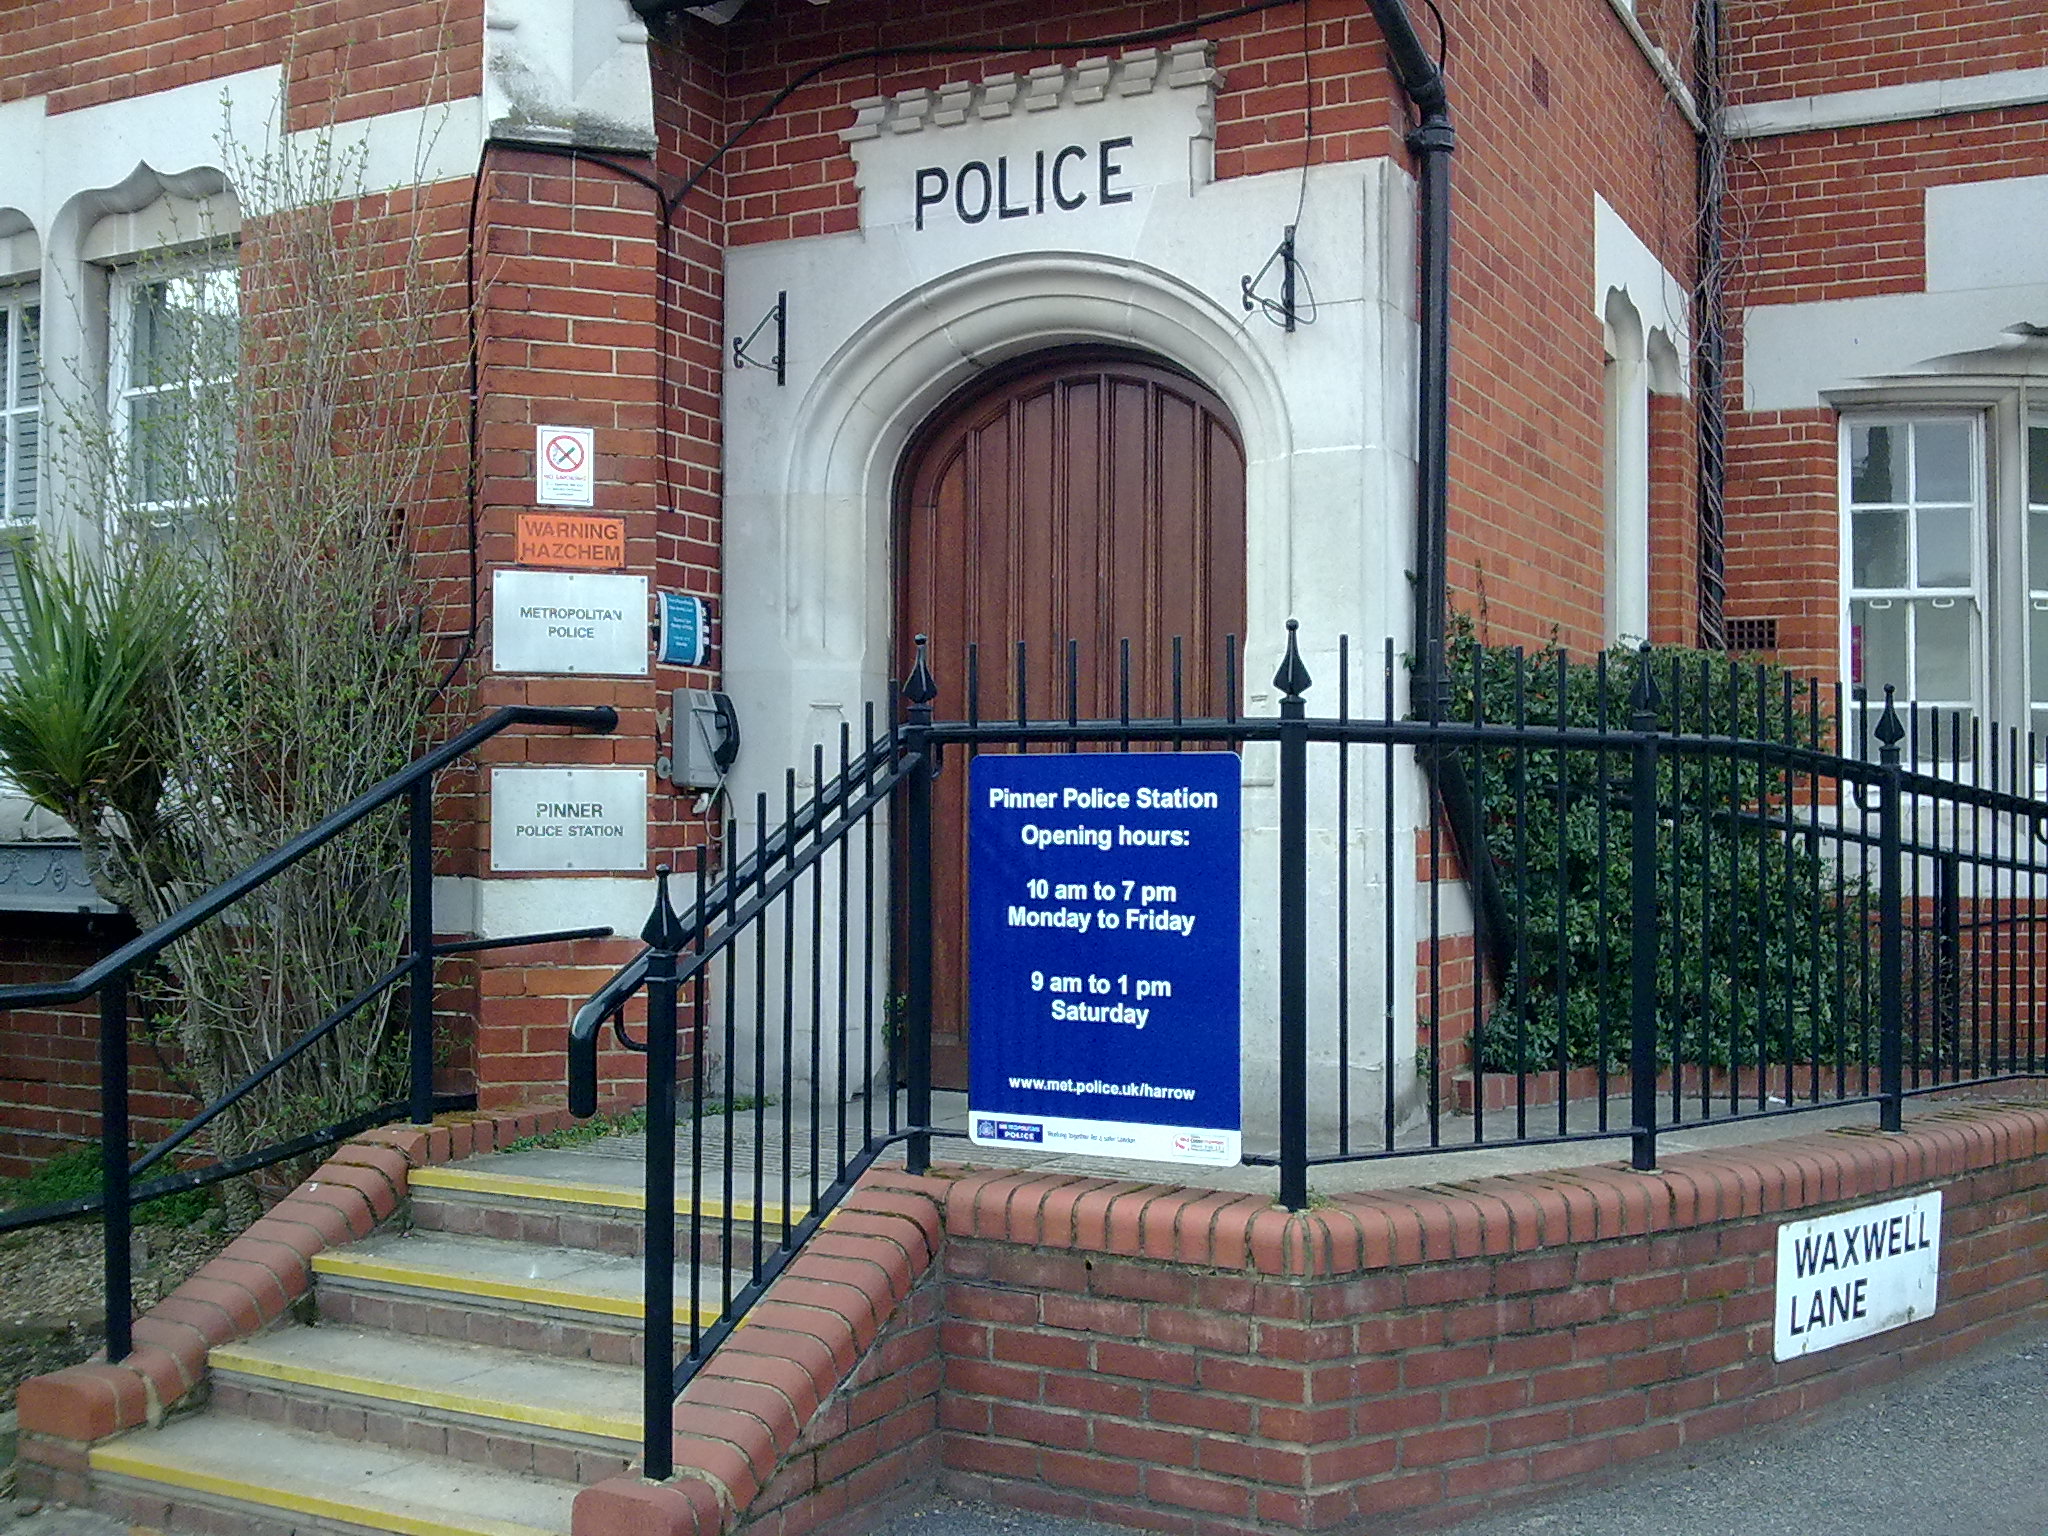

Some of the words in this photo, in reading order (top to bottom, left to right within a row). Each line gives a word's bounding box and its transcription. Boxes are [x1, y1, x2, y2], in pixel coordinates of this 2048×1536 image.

[915, 136, 1133, 231] POLICE
[525, 520, 618, 540] WARNING
[521, 542, 620, 561] HAZCHEM
[520, 606, 622, 621] METROPOLITAN
[548, 626, 594, 638] POLICE
[536, 803, 603, 818] PINNER
[989, 787, 1058, 808] Pinner
[1063, 787, 1130, 808] Police
[1136, 787, 1218, 809] Station
[516, 825, 562, 837] POLICE
[568, 825, 624, 837] STATION
[1021, 824, 1112, 850] Opening
[1119, 825, 1190, 846] hours:
[1027, 878, 1049, 899] 10
[1055, 882, 1088, 900] am
[1093, 880, 1116, 901] to
[1122, 880, 1136, 901] 7
[1142, 884, 1177, 906] pm
[1008, 906, 1092, 934] Monday
[1097, 909, 1120, 929] to
[1126, 908, 1196, 936] Friday
[1031, 971, 1044, 991] 9
[1050, 975, 1082, 993] am
[1088, 974, 1111, 994] to
[1117, 974, 1128, 995] 1
[1136, 979, 1172, 1000] pm
[1051, 1000, 1150, 1029] Saturday
[1008, 1077, 1196, 1101] www.met.police.uk/harrow
[1794, 1211, 1931, 1279] WAXWELL
[1790, 1278, 1868, 1336] LANE
